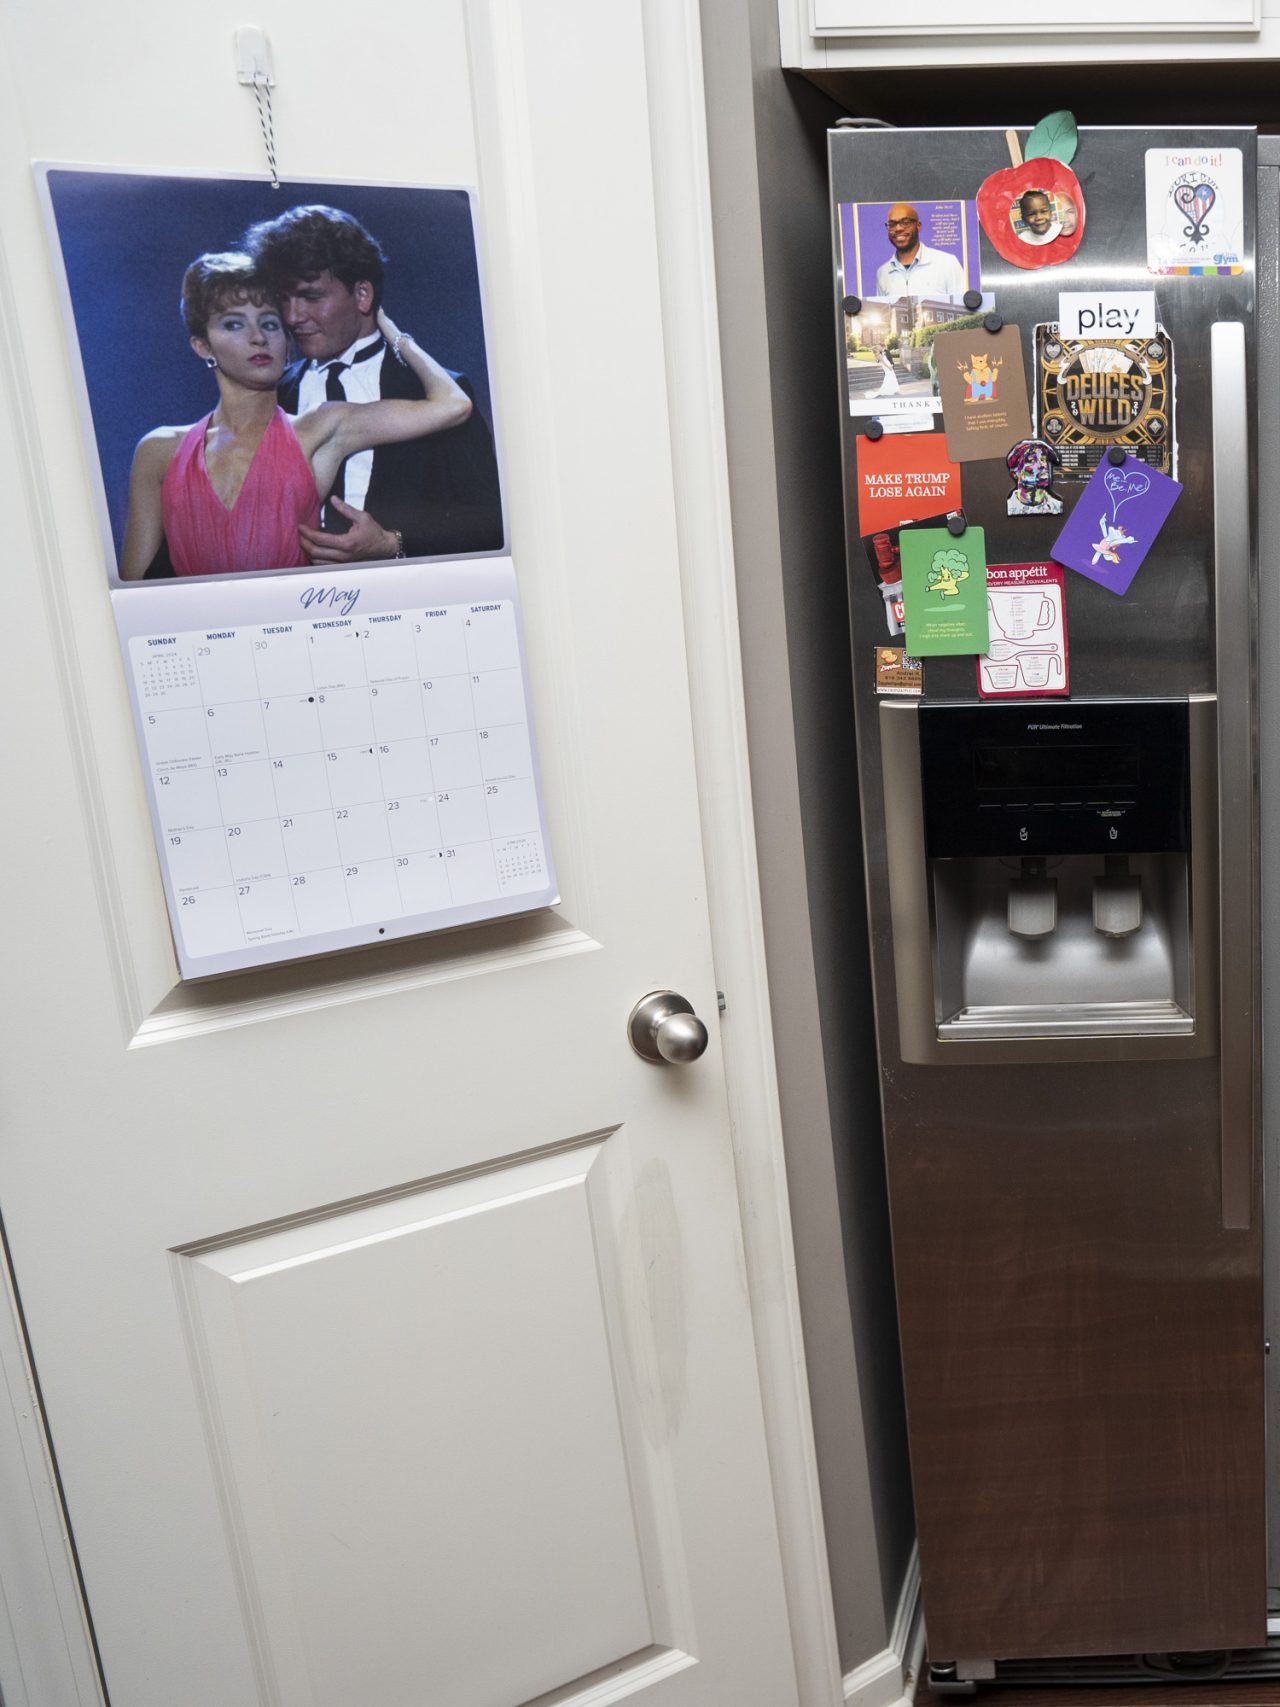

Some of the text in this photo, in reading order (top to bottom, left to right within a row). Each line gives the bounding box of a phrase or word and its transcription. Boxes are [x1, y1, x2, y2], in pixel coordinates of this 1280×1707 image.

[1171, 155, 1192, 166] can
[1213, 253, 1239, 264] gym
[1078, 302, 1140, 335] play
[1065, 372, 1144, 401] DEUCES
[891, 400, 931, 409] THANK
[1078, 398, 1131, 425] WILD
[864, 473, 951, 485] MAKE TRUMP
[869, 486, 946, 498] LOSE AGAIN
[986, 565, 1048, 581] bon appétit
[300, 586, 361, 616] May
[147, 604, 502, 646] SUNDAY MONDAY TUESDAY WEDNESDAY THURSDAY FRIDAY SATURDAY
[197, 647, 211, 657] 29
[254, 641, 268, 650] 30
[364, 630, 370, 639] 2
[415, 625, 421, 633] 3
[465, 619, 471, 627] 4
[148, 675, 480, 724] 5 6 7 8 9 10 11
[159, 731, 489, 785] 12 13 14 15 16 17 18
[170, 786, 498, 846] 19 20 21 22 23 24 25
[182, 849, 456, 906] 26 27 28 29 30 31
